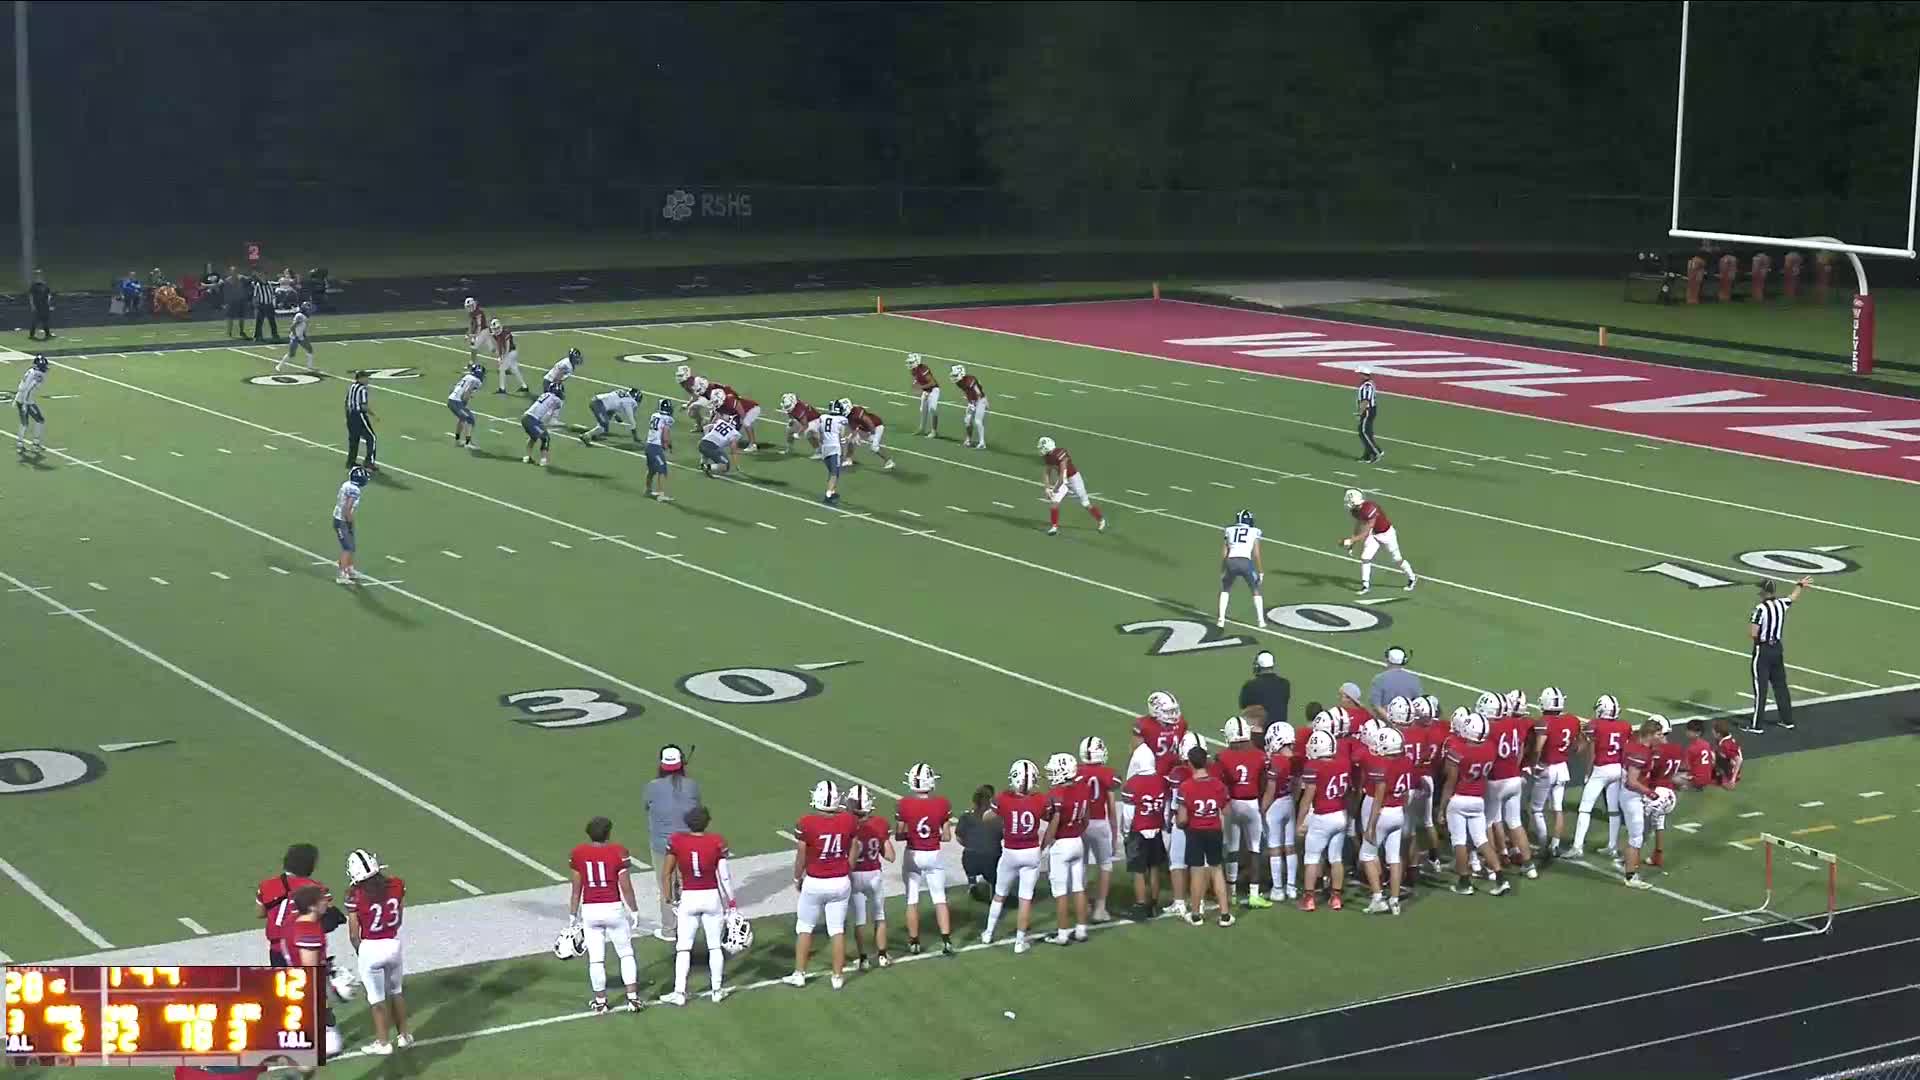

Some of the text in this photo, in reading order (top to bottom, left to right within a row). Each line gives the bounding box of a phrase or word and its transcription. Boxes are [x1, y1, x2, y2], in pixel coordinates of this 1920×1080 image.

[701, 193, 752, 217] RSHS
[1852, 308, 1861, 372] WOLVES
[1162, 331, 1920, 461] WOLVE
[824, 418, 833, 433] 8
[1233, 528, 1248, 543] 12
[1498, 728, 1520, 758] 64
[1558, 728, 1571, 752] 3
[1608, 732, 1621, 756] 5
[1701, 749, 1710, 765] 2
[1235, 764, 1249, 785] 2
[1326, 772, 1350, 800] 65
[1393, 771, 1411, 798] 61
[1193, 799, 1218, 818] 22
[916, 816, 931, 839] 6
[1009, 810, 1035, 836] 19
[817, 832, 844, 860] 74
[584, 860, 608, 888] 11
[690, 850, 703, 878] 1
[367, 897, 401, 933] 23
